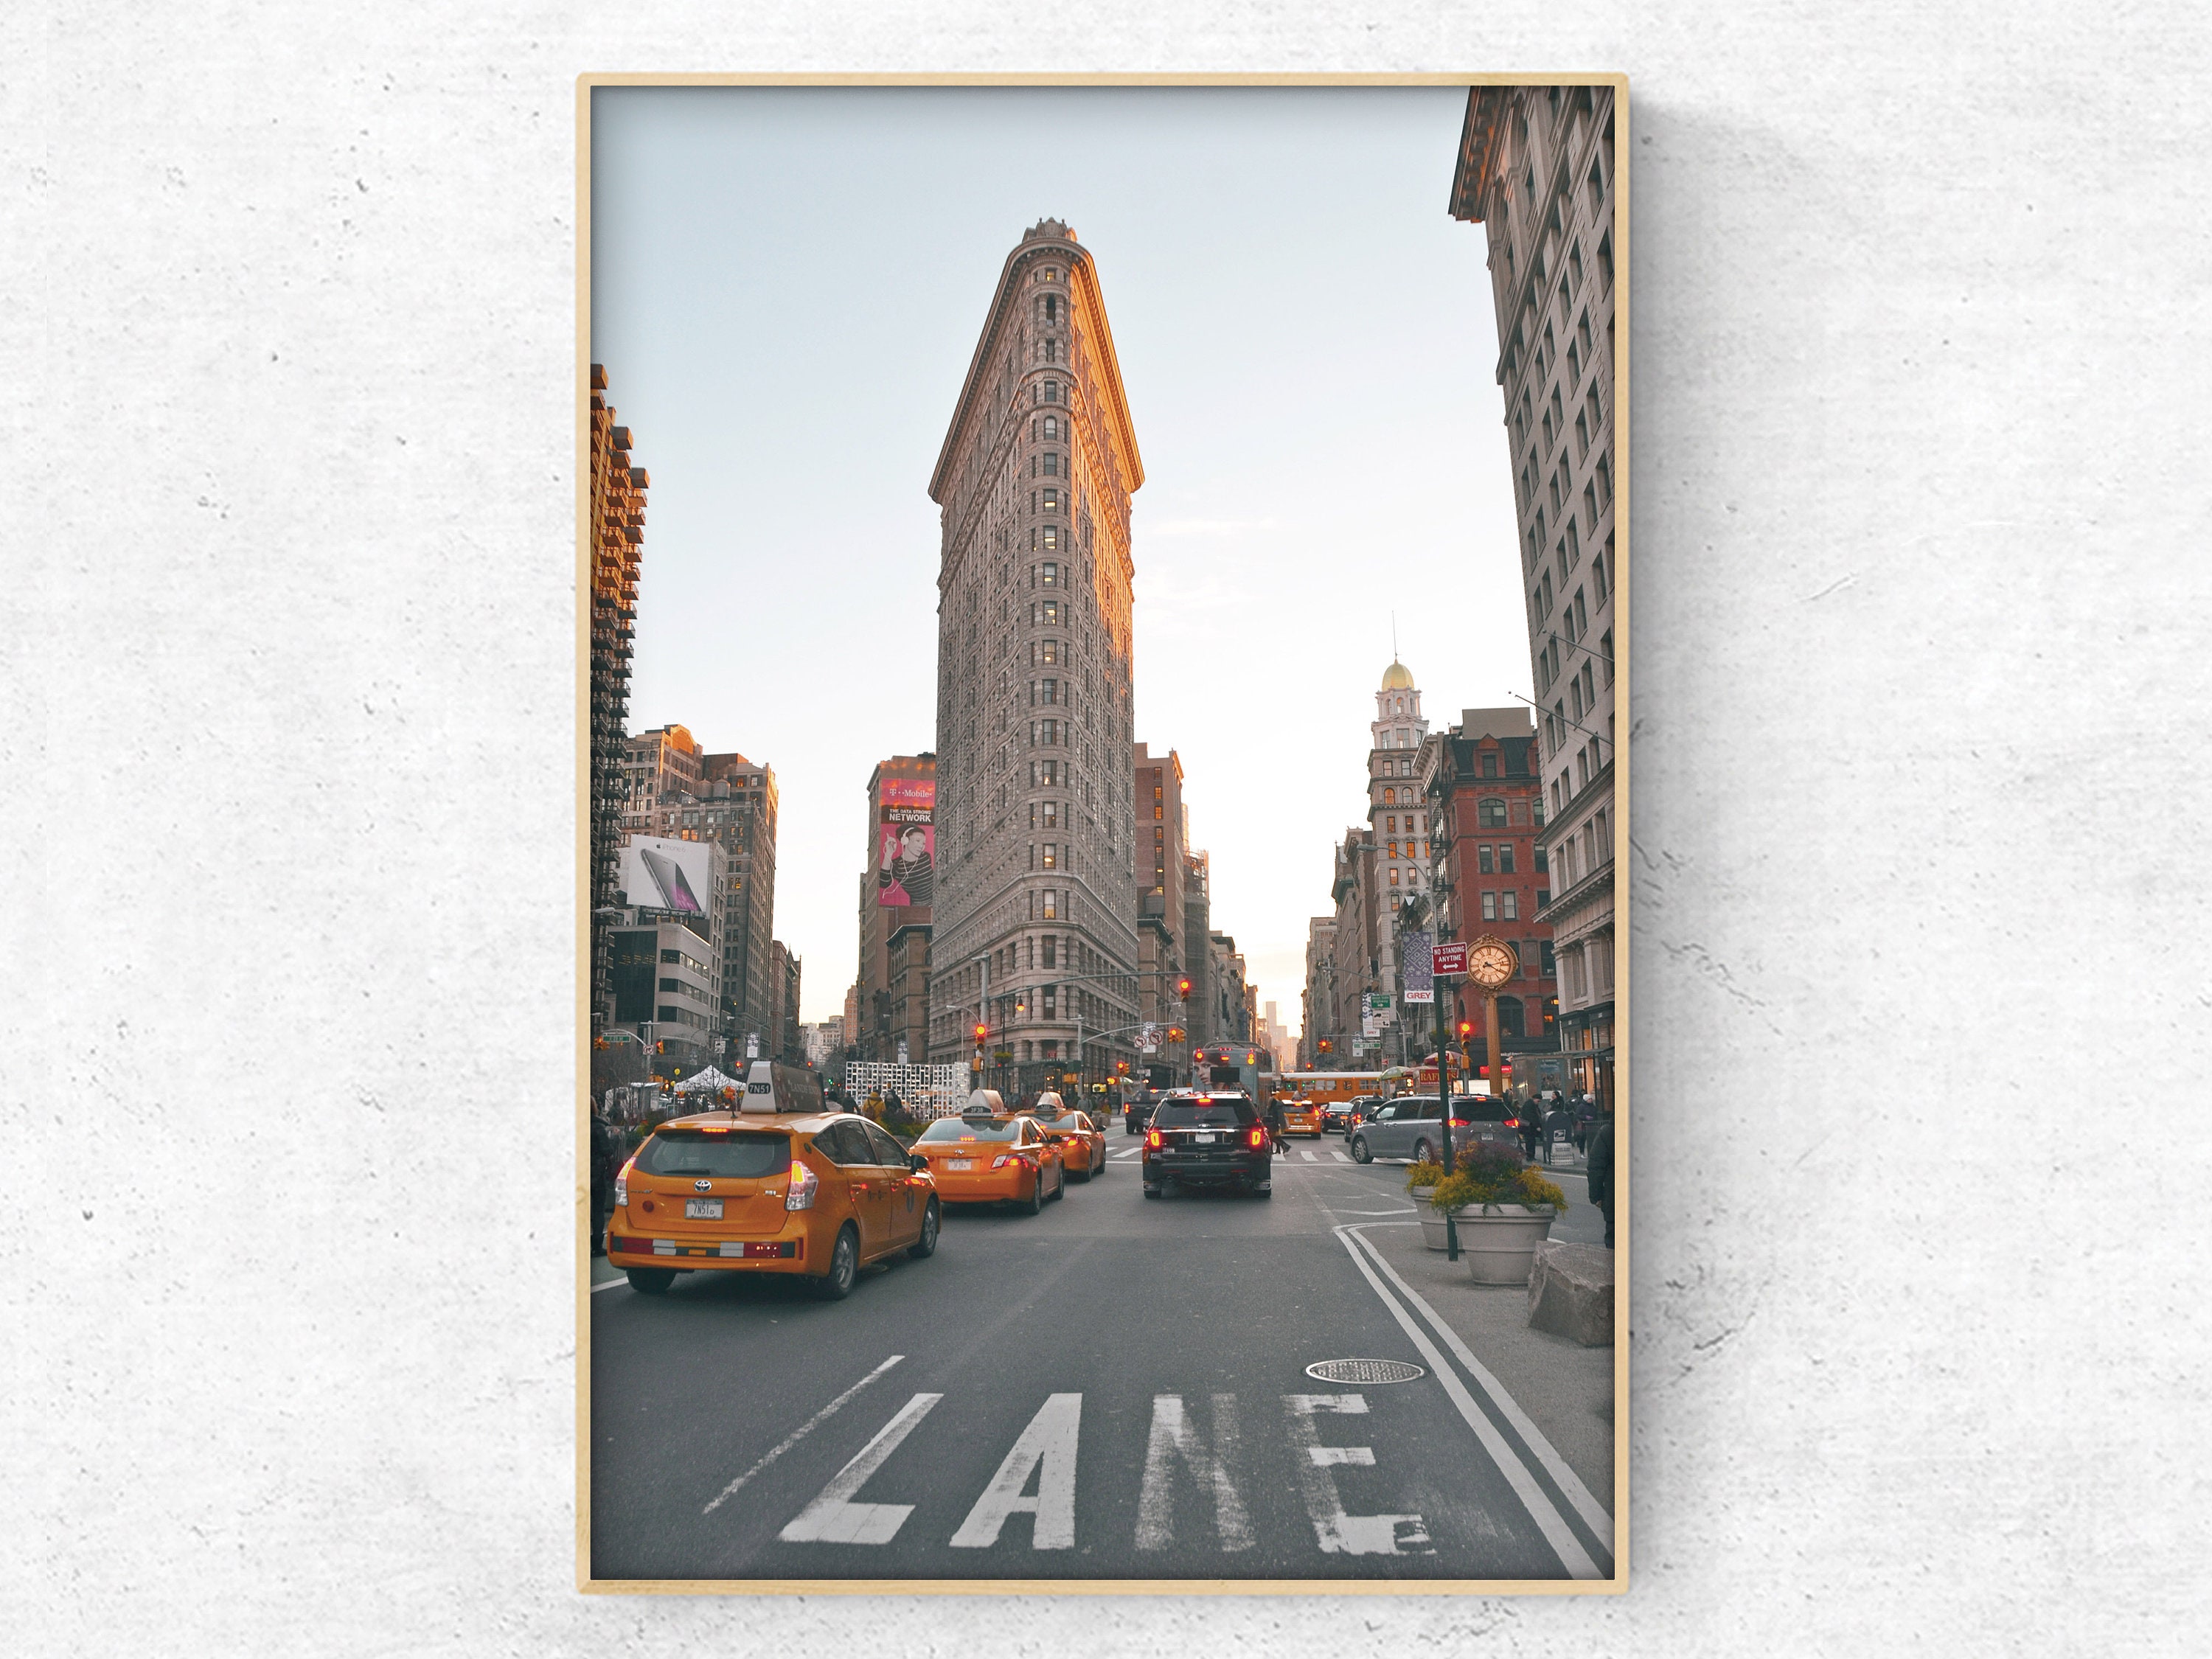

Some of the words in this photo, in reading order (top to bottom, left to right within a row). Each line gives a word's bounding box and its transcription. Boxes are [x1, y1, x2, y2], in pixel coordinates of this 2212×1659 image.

[889, 813, 931, 822] NETWORK
[1442, 945, 1465, 954] STANDING
[1418, 953, 1430, 967] ART
[1439, 954, 1462, 962] ANYTIME
[749, 1085, 769, 1093] 7N51
[778, 1392, 1438, 1556] LANE
